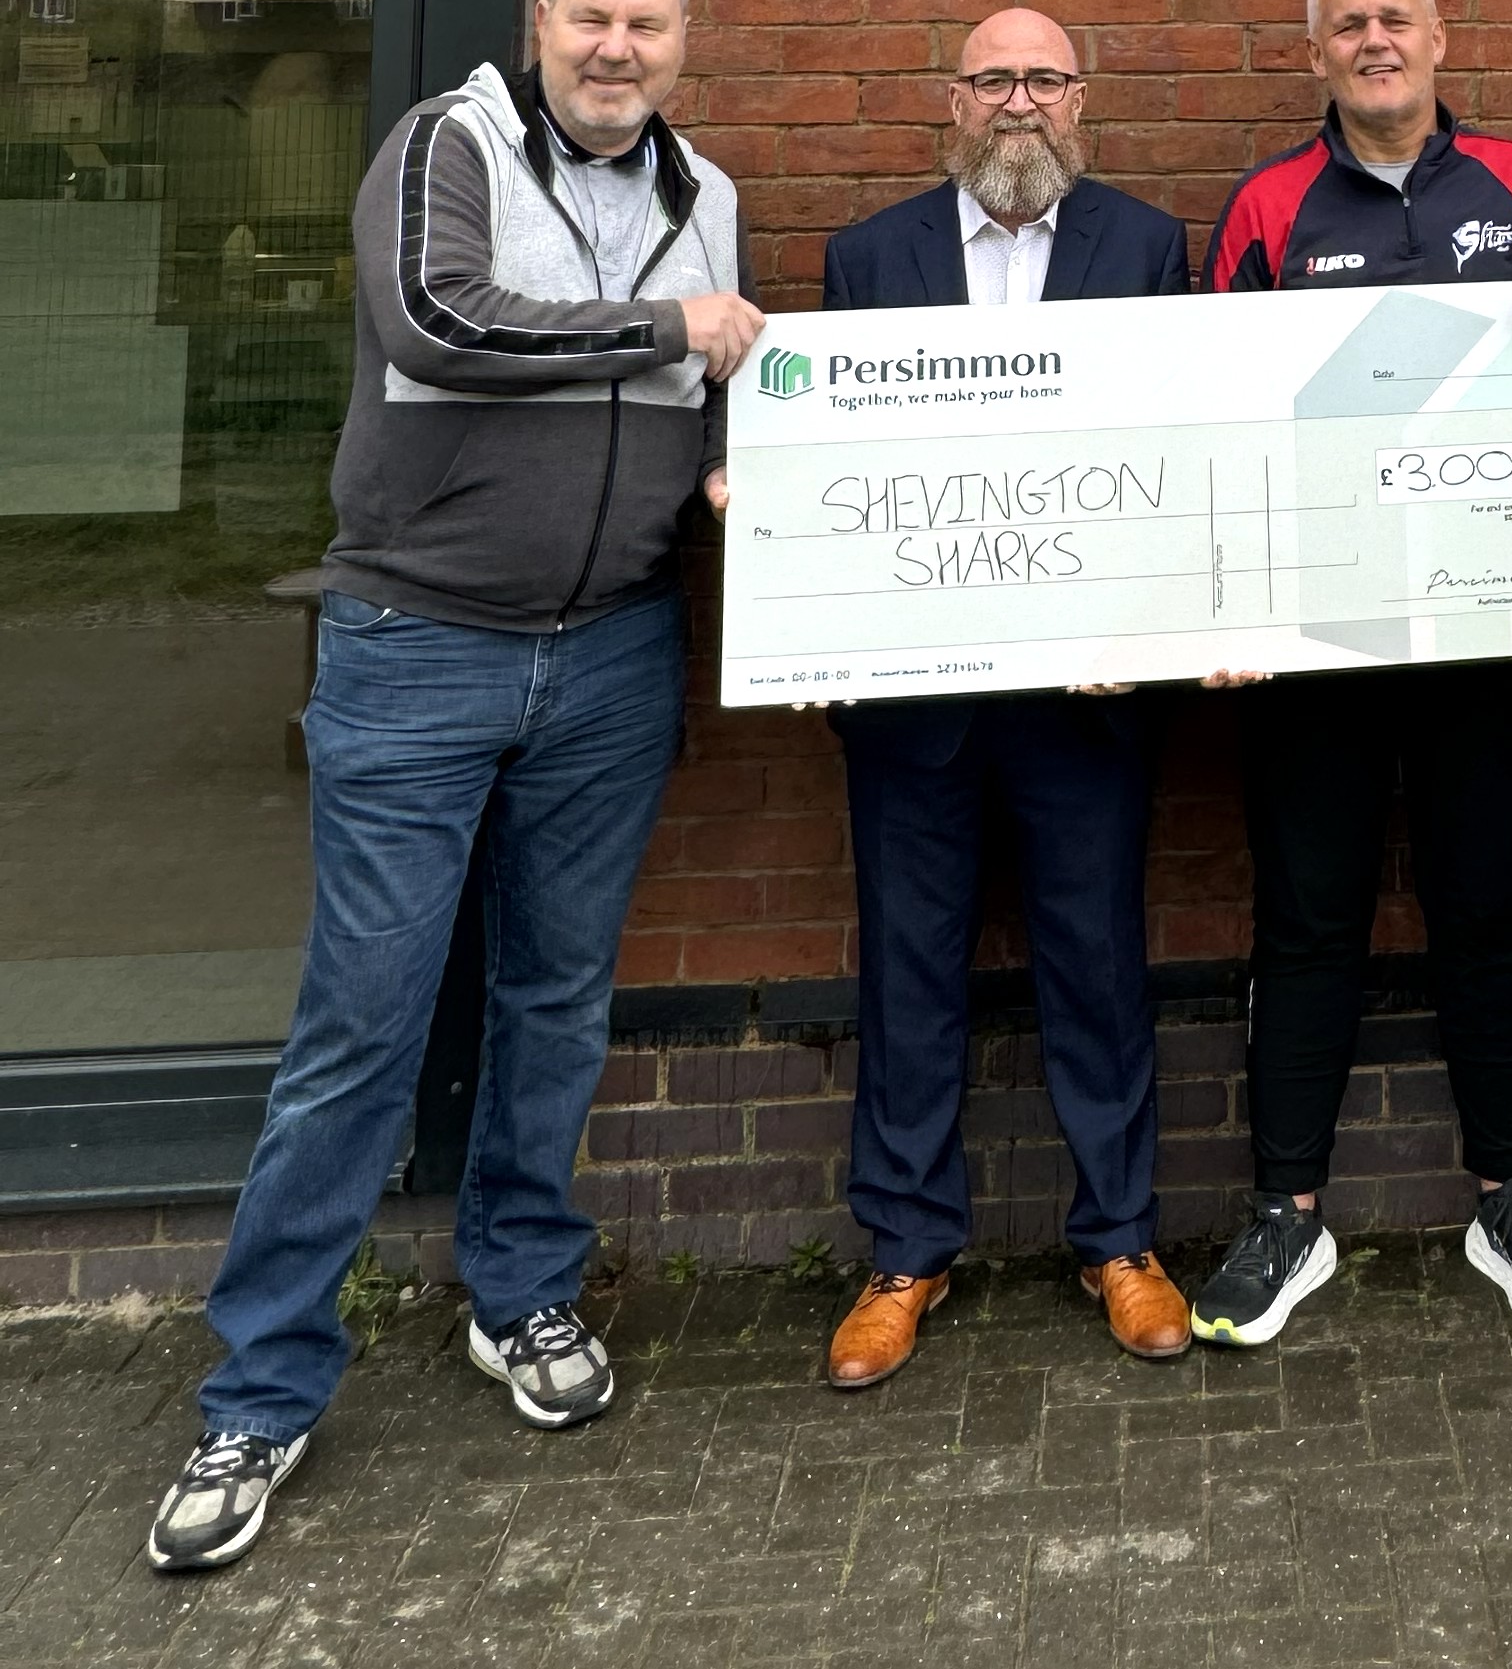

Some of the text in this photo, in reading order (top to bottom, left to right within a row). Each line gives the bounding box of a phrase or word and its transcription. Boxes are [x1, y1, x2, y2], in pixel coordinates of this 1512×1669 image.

[829, 348, 1062, 385] Persimmon
[829, 392, 903, 412] Together,
[934, 388, 975, 402] make
[981, 389, 1014, 405] your
[821, 456, 1164, 533] SHEVINGTON
[893, 531, 1083, 586] SHARKS
